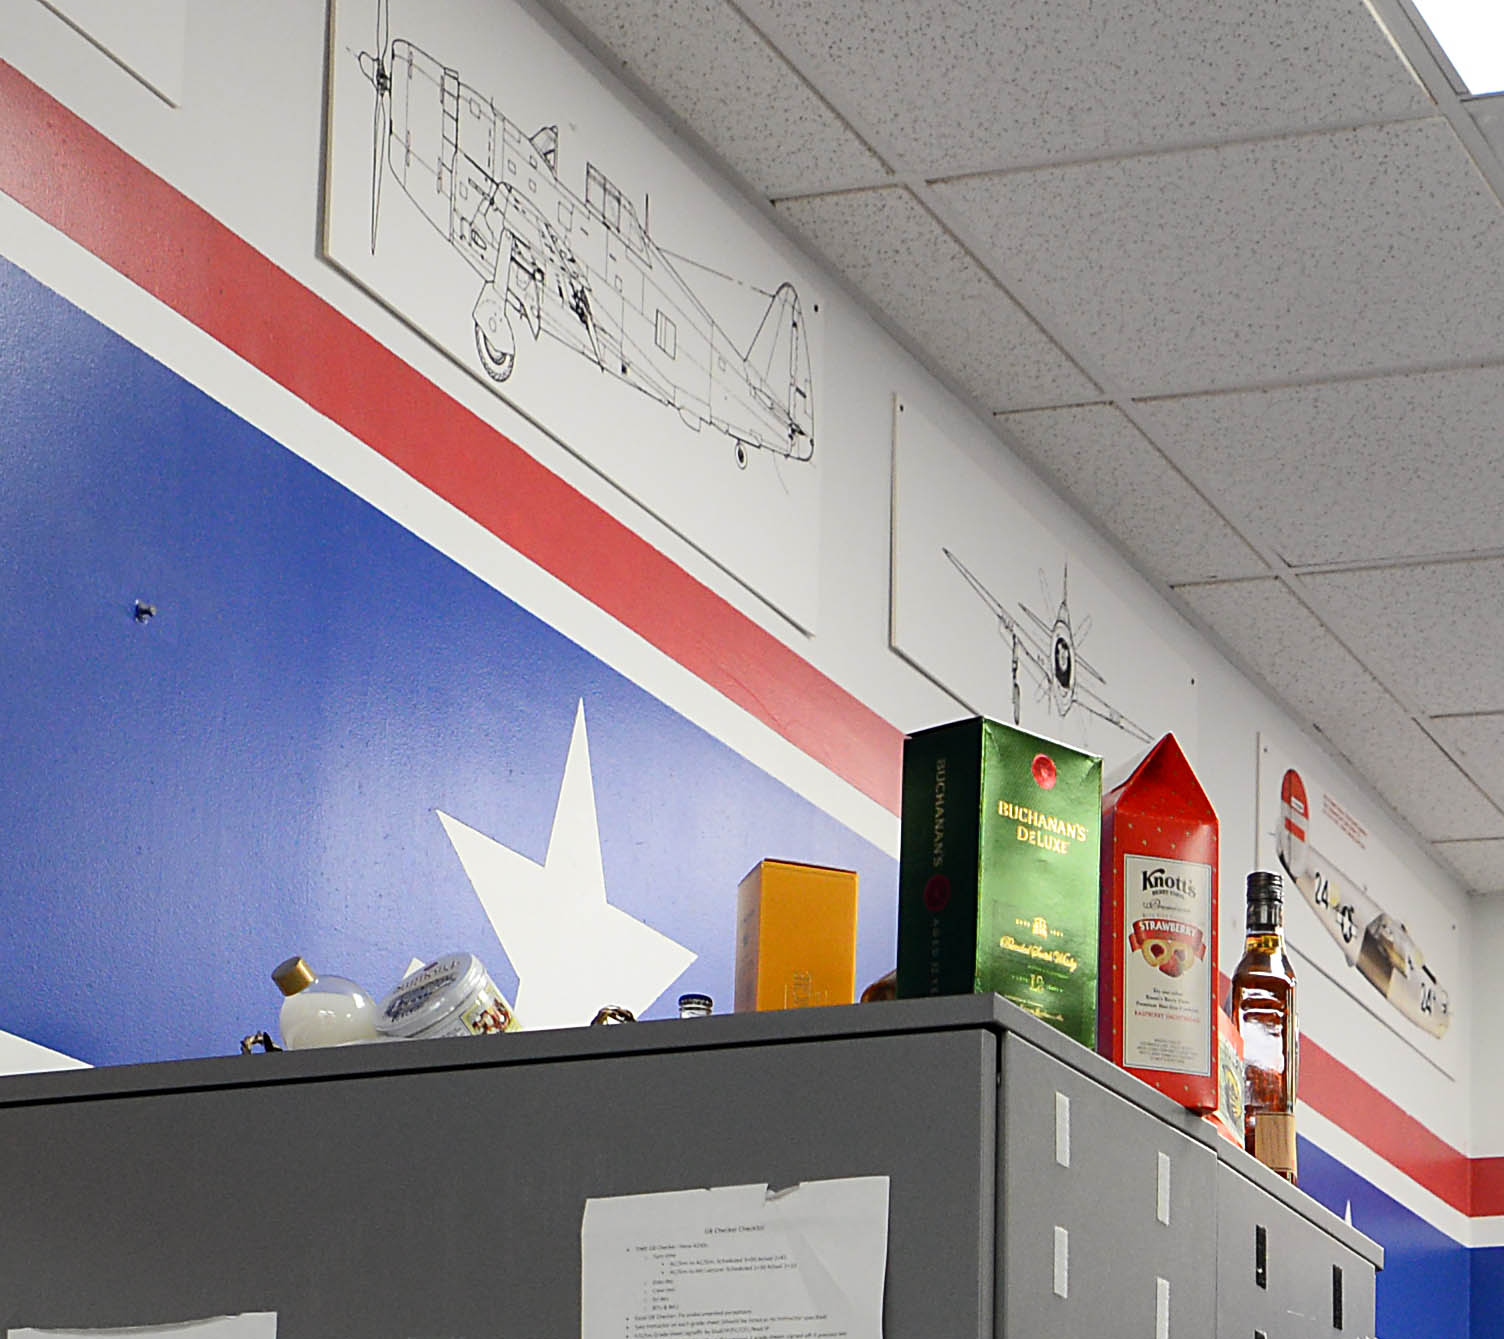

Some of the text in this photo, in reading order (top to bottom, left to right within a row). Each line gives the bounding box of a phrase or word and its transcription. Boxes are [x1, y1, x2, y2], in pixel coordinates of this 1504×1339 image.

[997, 799, 1089, 842] BUCHANAN'S
[1141, 867, 1197, 898] Knott's
[1138, 920, 1196, 937] STRAWBERRY
